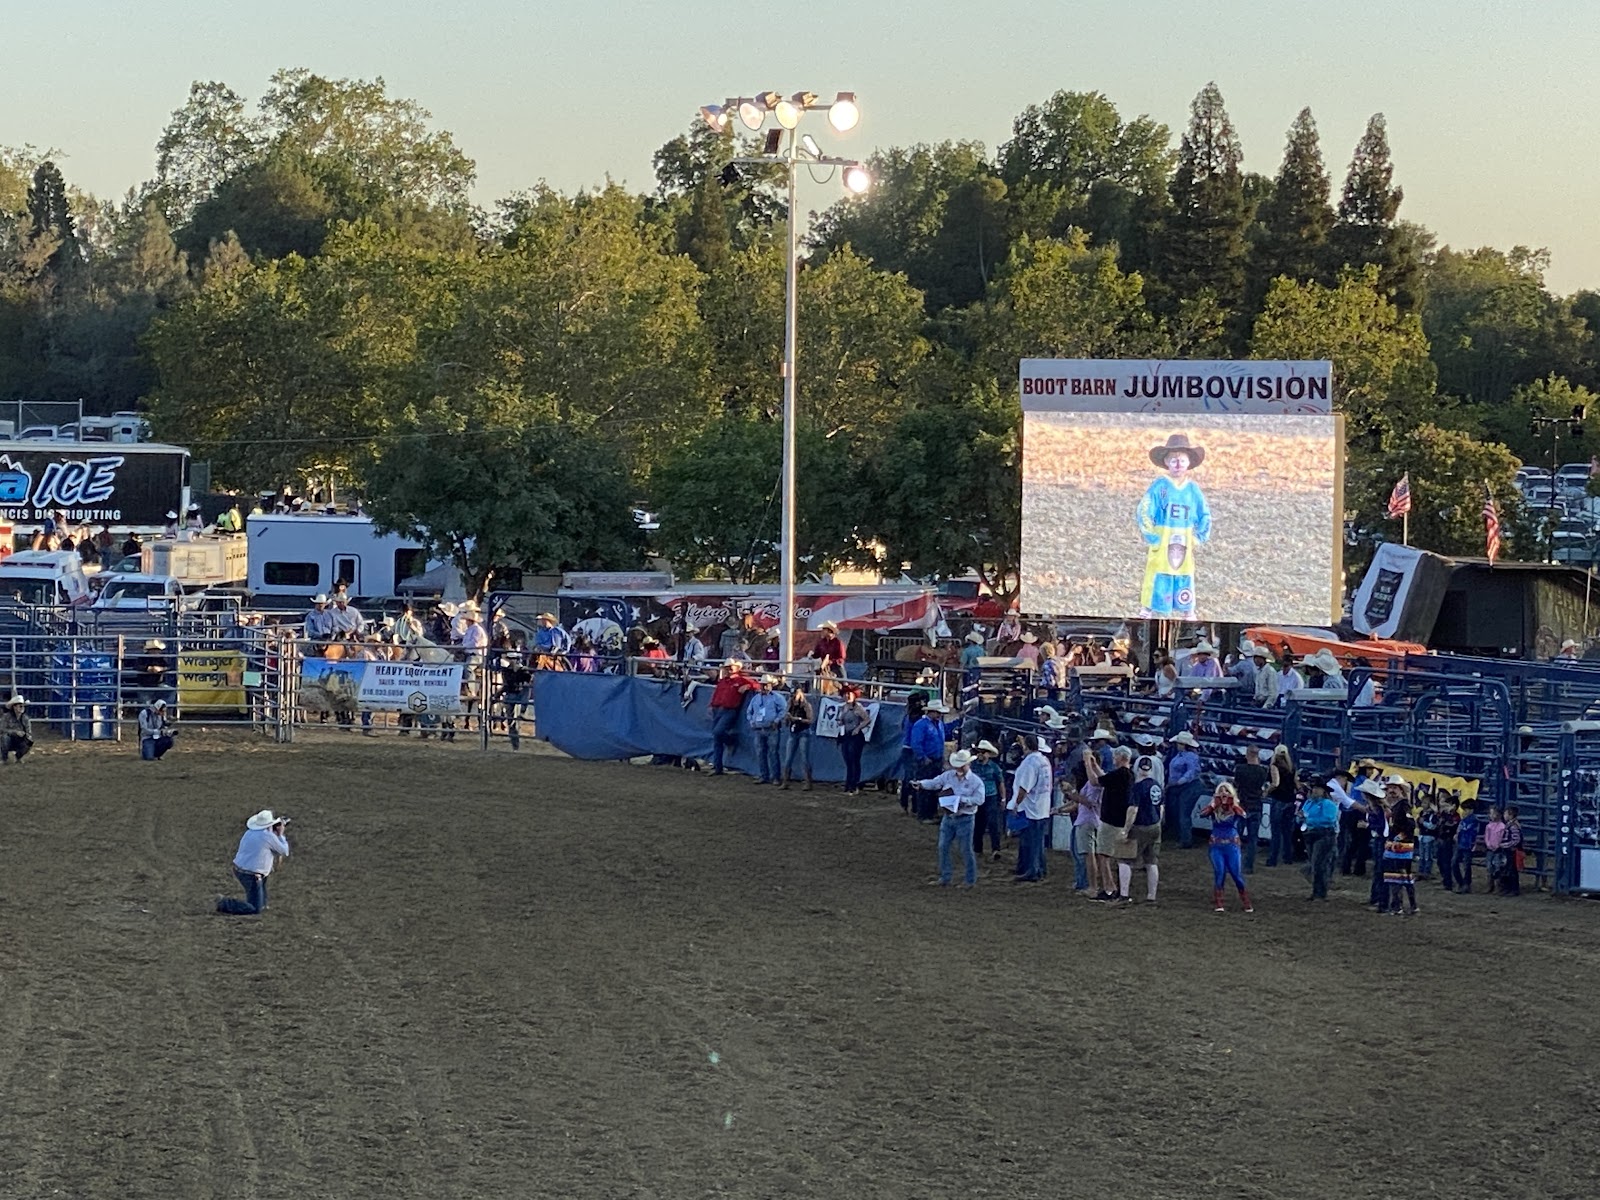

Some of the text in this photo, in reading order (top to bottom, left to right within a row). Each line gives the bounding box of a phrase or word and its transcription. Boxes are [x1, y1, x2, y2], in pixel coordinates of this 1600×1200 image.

[1023, 375, 1328, 400] BOOT BARN JUMBOVISION
[33, 456, 125, 508] ICE
[375, 665, 403, 676] HEAVY
